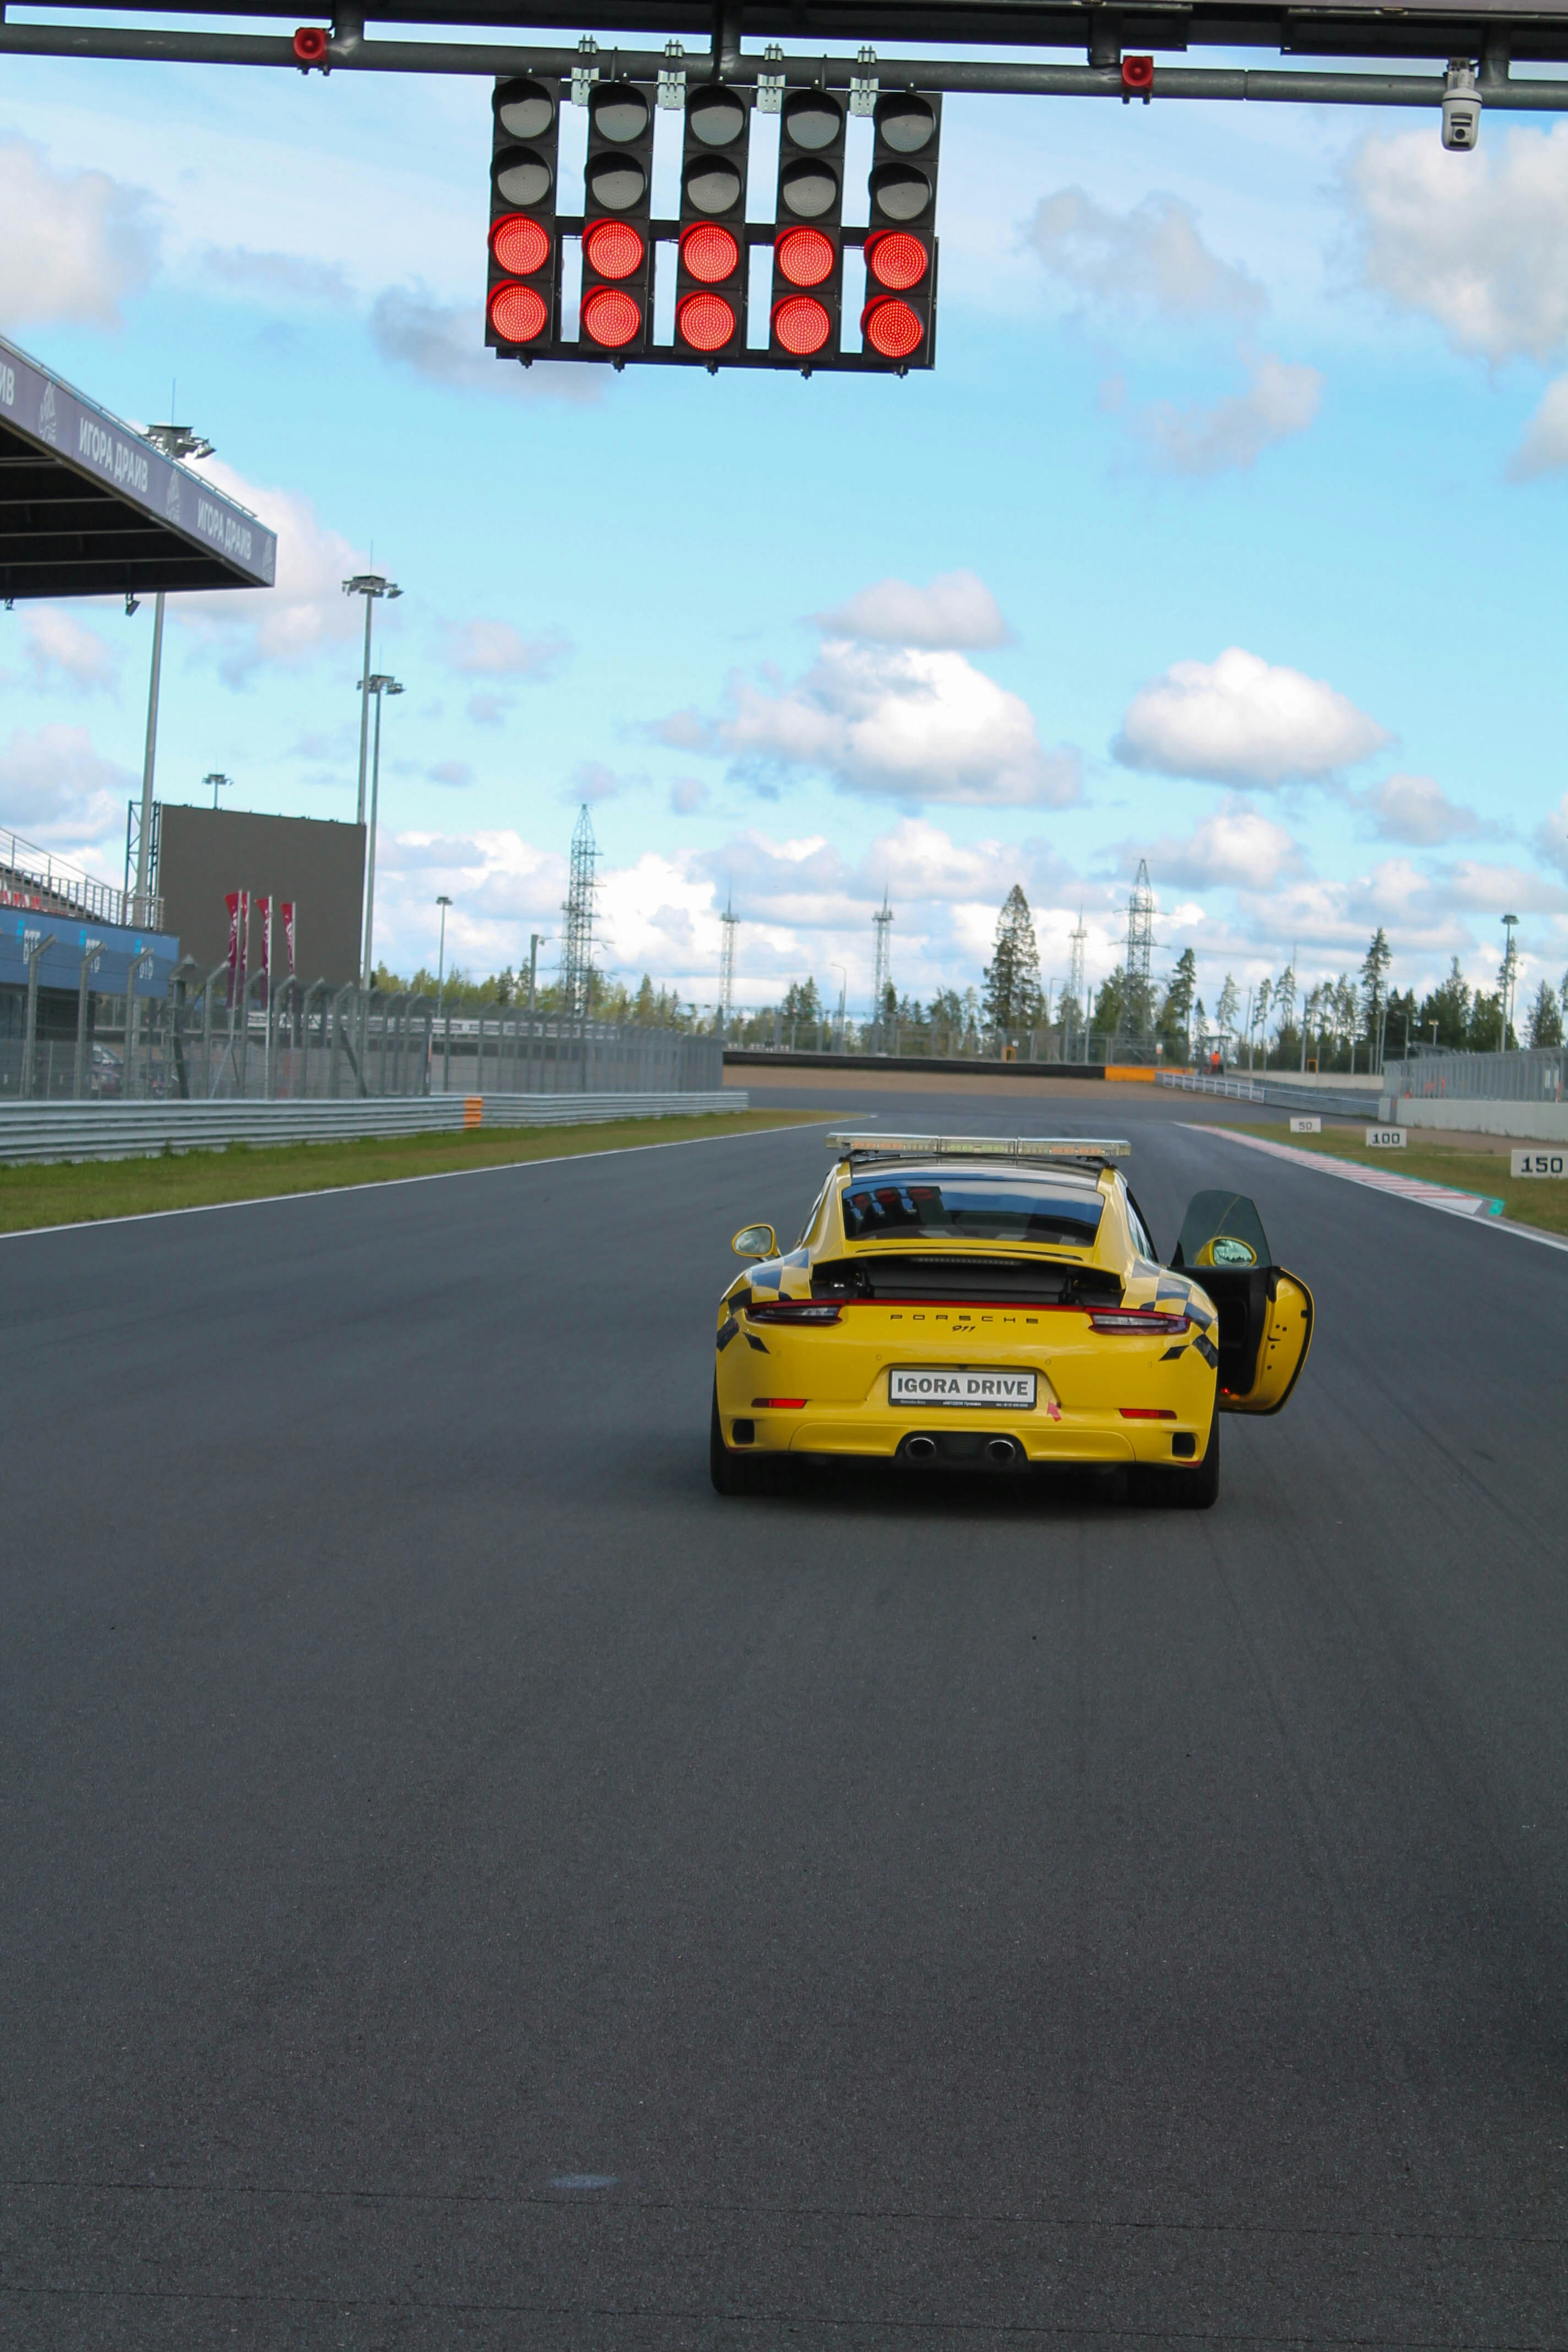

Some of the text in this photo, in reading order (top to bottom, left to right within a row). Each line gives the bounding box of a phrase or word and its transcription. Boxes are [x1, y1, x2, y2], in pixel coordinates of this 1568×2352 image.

[79, 417, 113, 472] ИГОРА
[198, 497, 224, 543] ИГОРА
[1299, 1121, 1313, 1130] 50
[1371, 1133, 1401, 1144] 100
[1521, 1156, 1563, 1173] 150
[890, 1314, 1039, 1324] PORSCHE
[897, 1378, 1028, 1396] IGORA DRIVE
